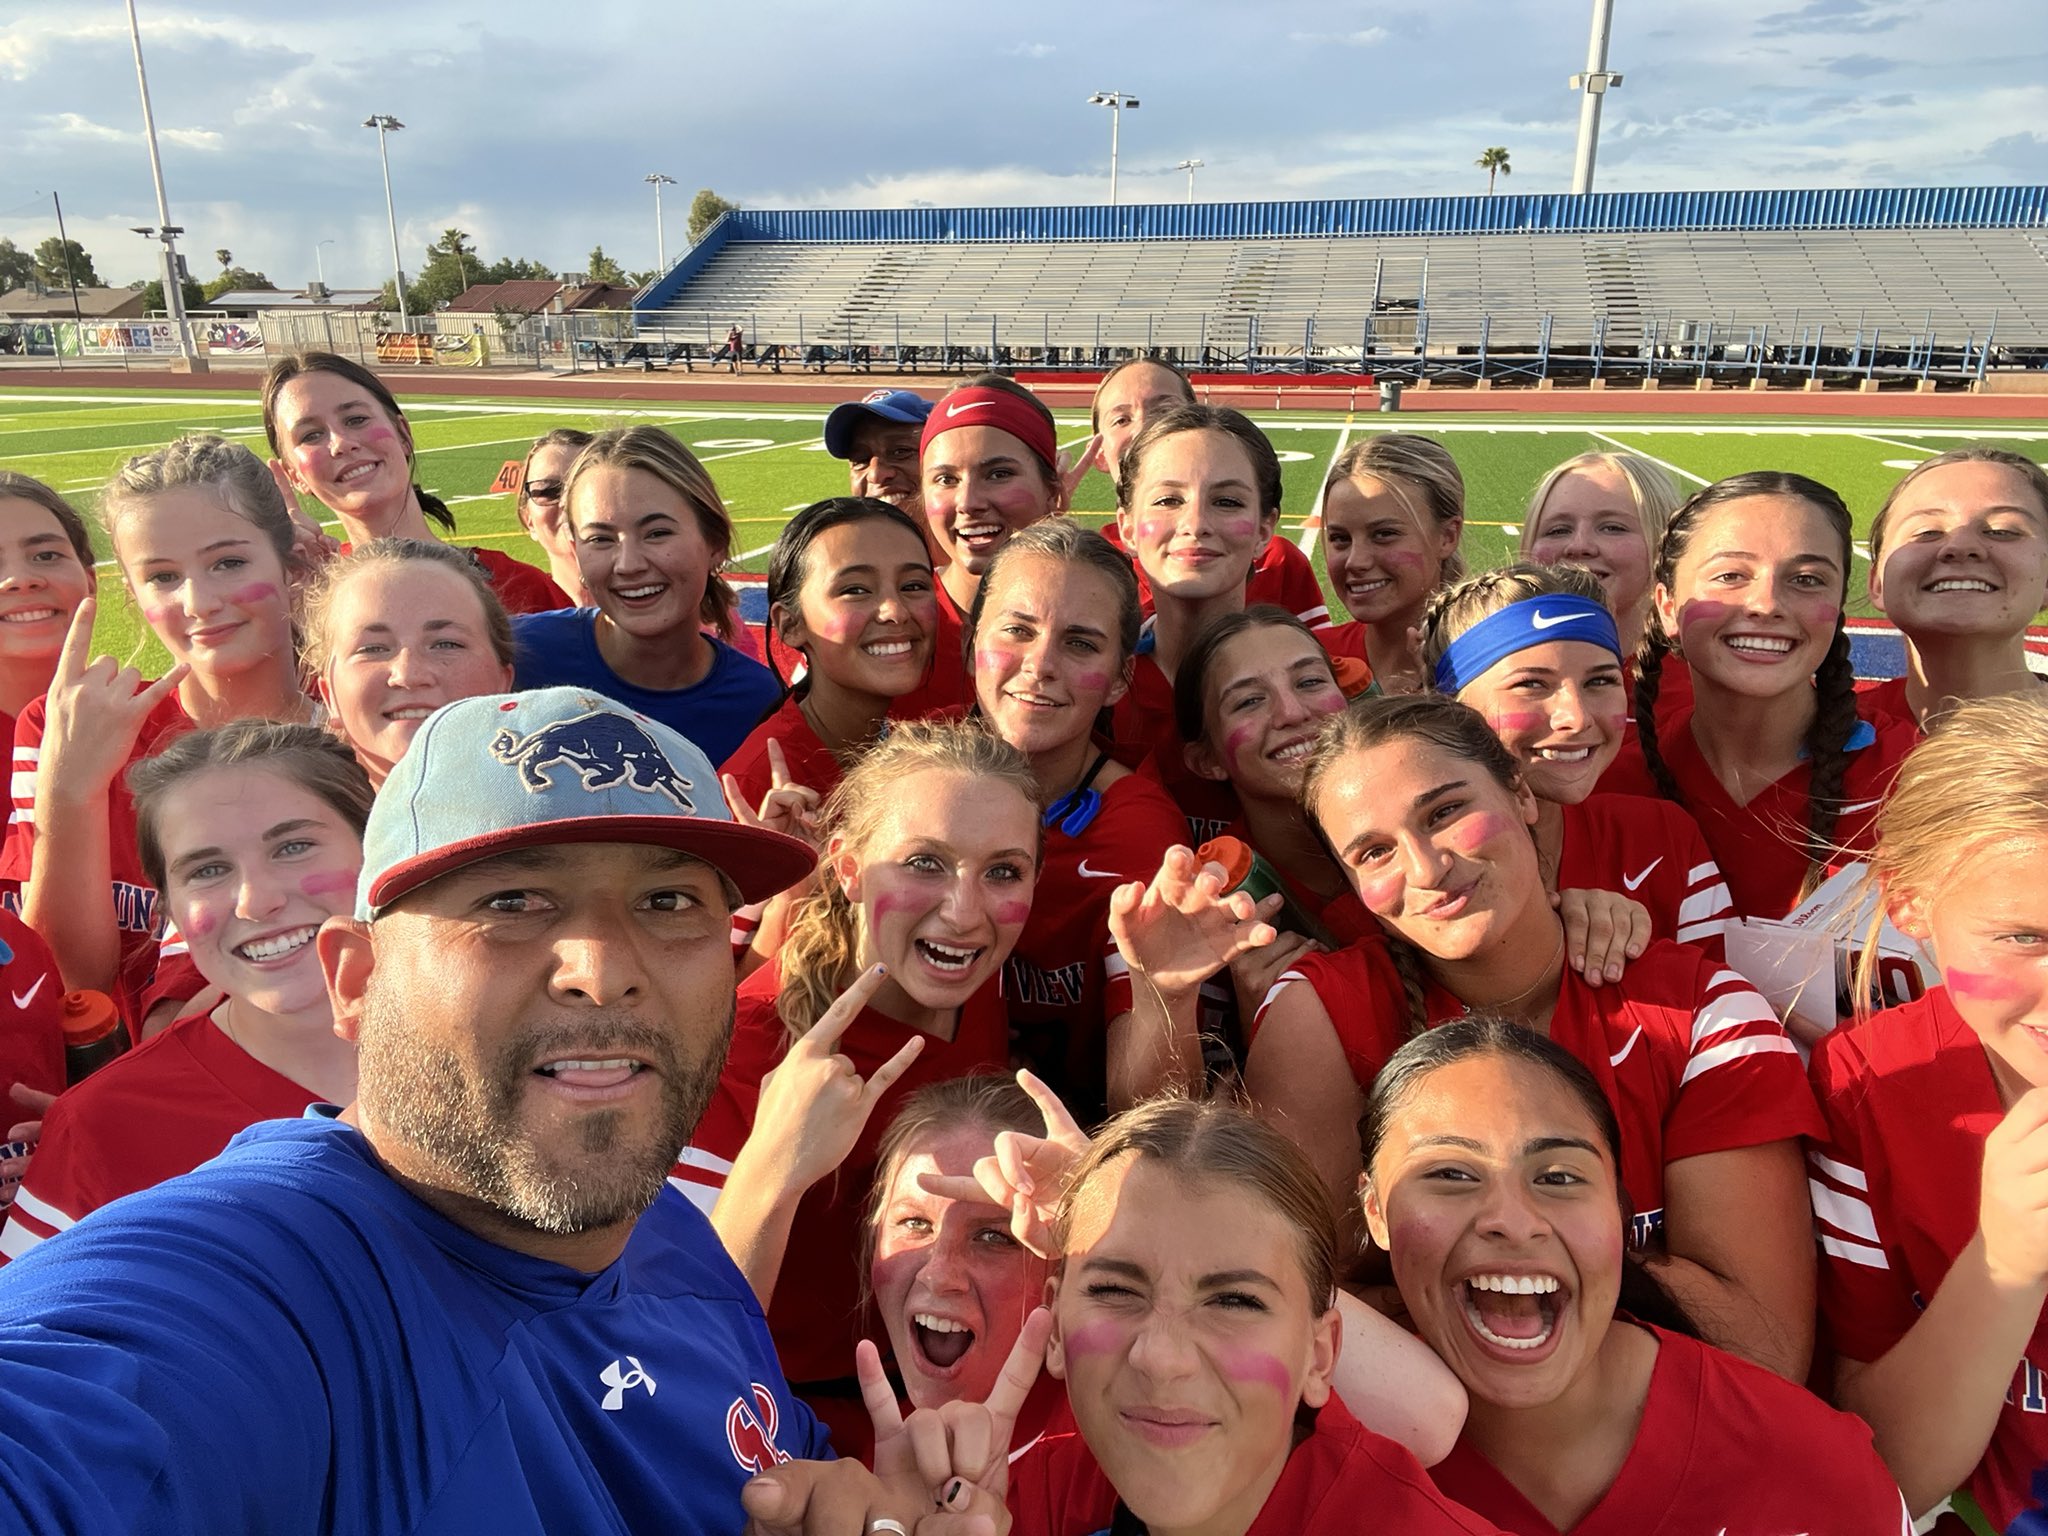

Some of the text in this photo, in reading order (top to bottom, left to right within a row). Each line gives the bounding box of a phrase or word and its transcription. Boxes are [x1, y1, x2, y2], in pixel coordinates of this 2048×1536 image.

[152, 325, 169, 337] A/C
[498, 466, 520, 489] 40
[1791, 903, 1825, 927] Wilson
[1012, 956, 1086, 1006] VIEW
